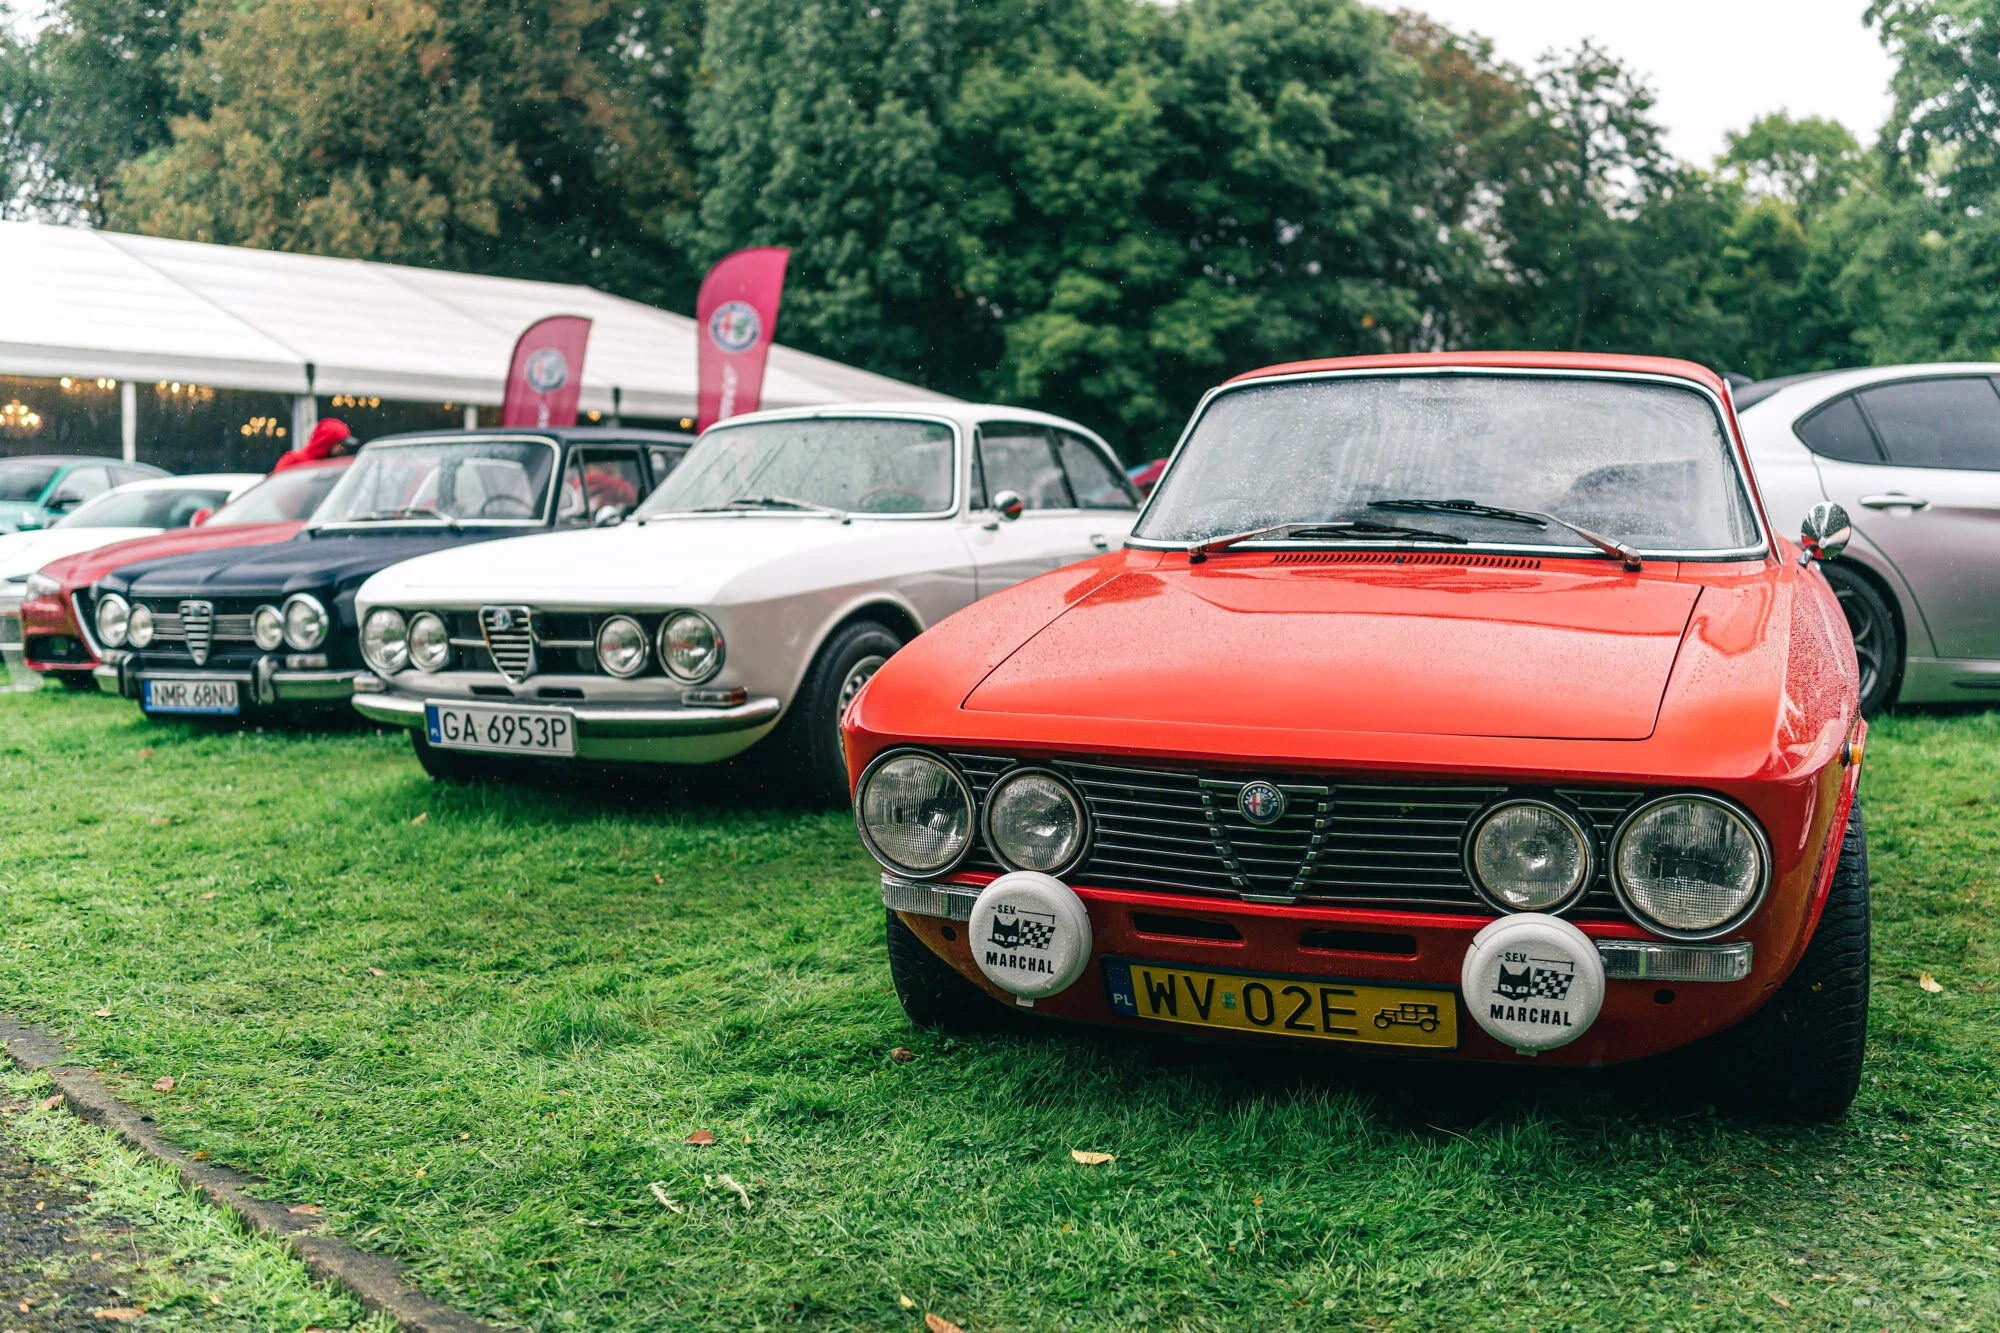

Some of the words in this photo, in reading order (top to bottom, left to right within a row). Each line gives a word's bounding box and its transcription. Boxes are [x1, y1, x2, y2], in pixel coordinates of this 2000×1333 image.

[154, 684, 188, 705] NMR
[193, 685, 236, 706] 68NU
[443, 711, 478, 743] GA
[487, 715, 567, 748] 6953P
[985, 951, 1055, 975] MARCHAL
[1113, 992, 1133, 1006] PL
[1143, 970, 1216, 1021] WV
[1241, 981, 1359, 1036] 02E
[1490, 1004, 1572, 1027] MARCHAL
